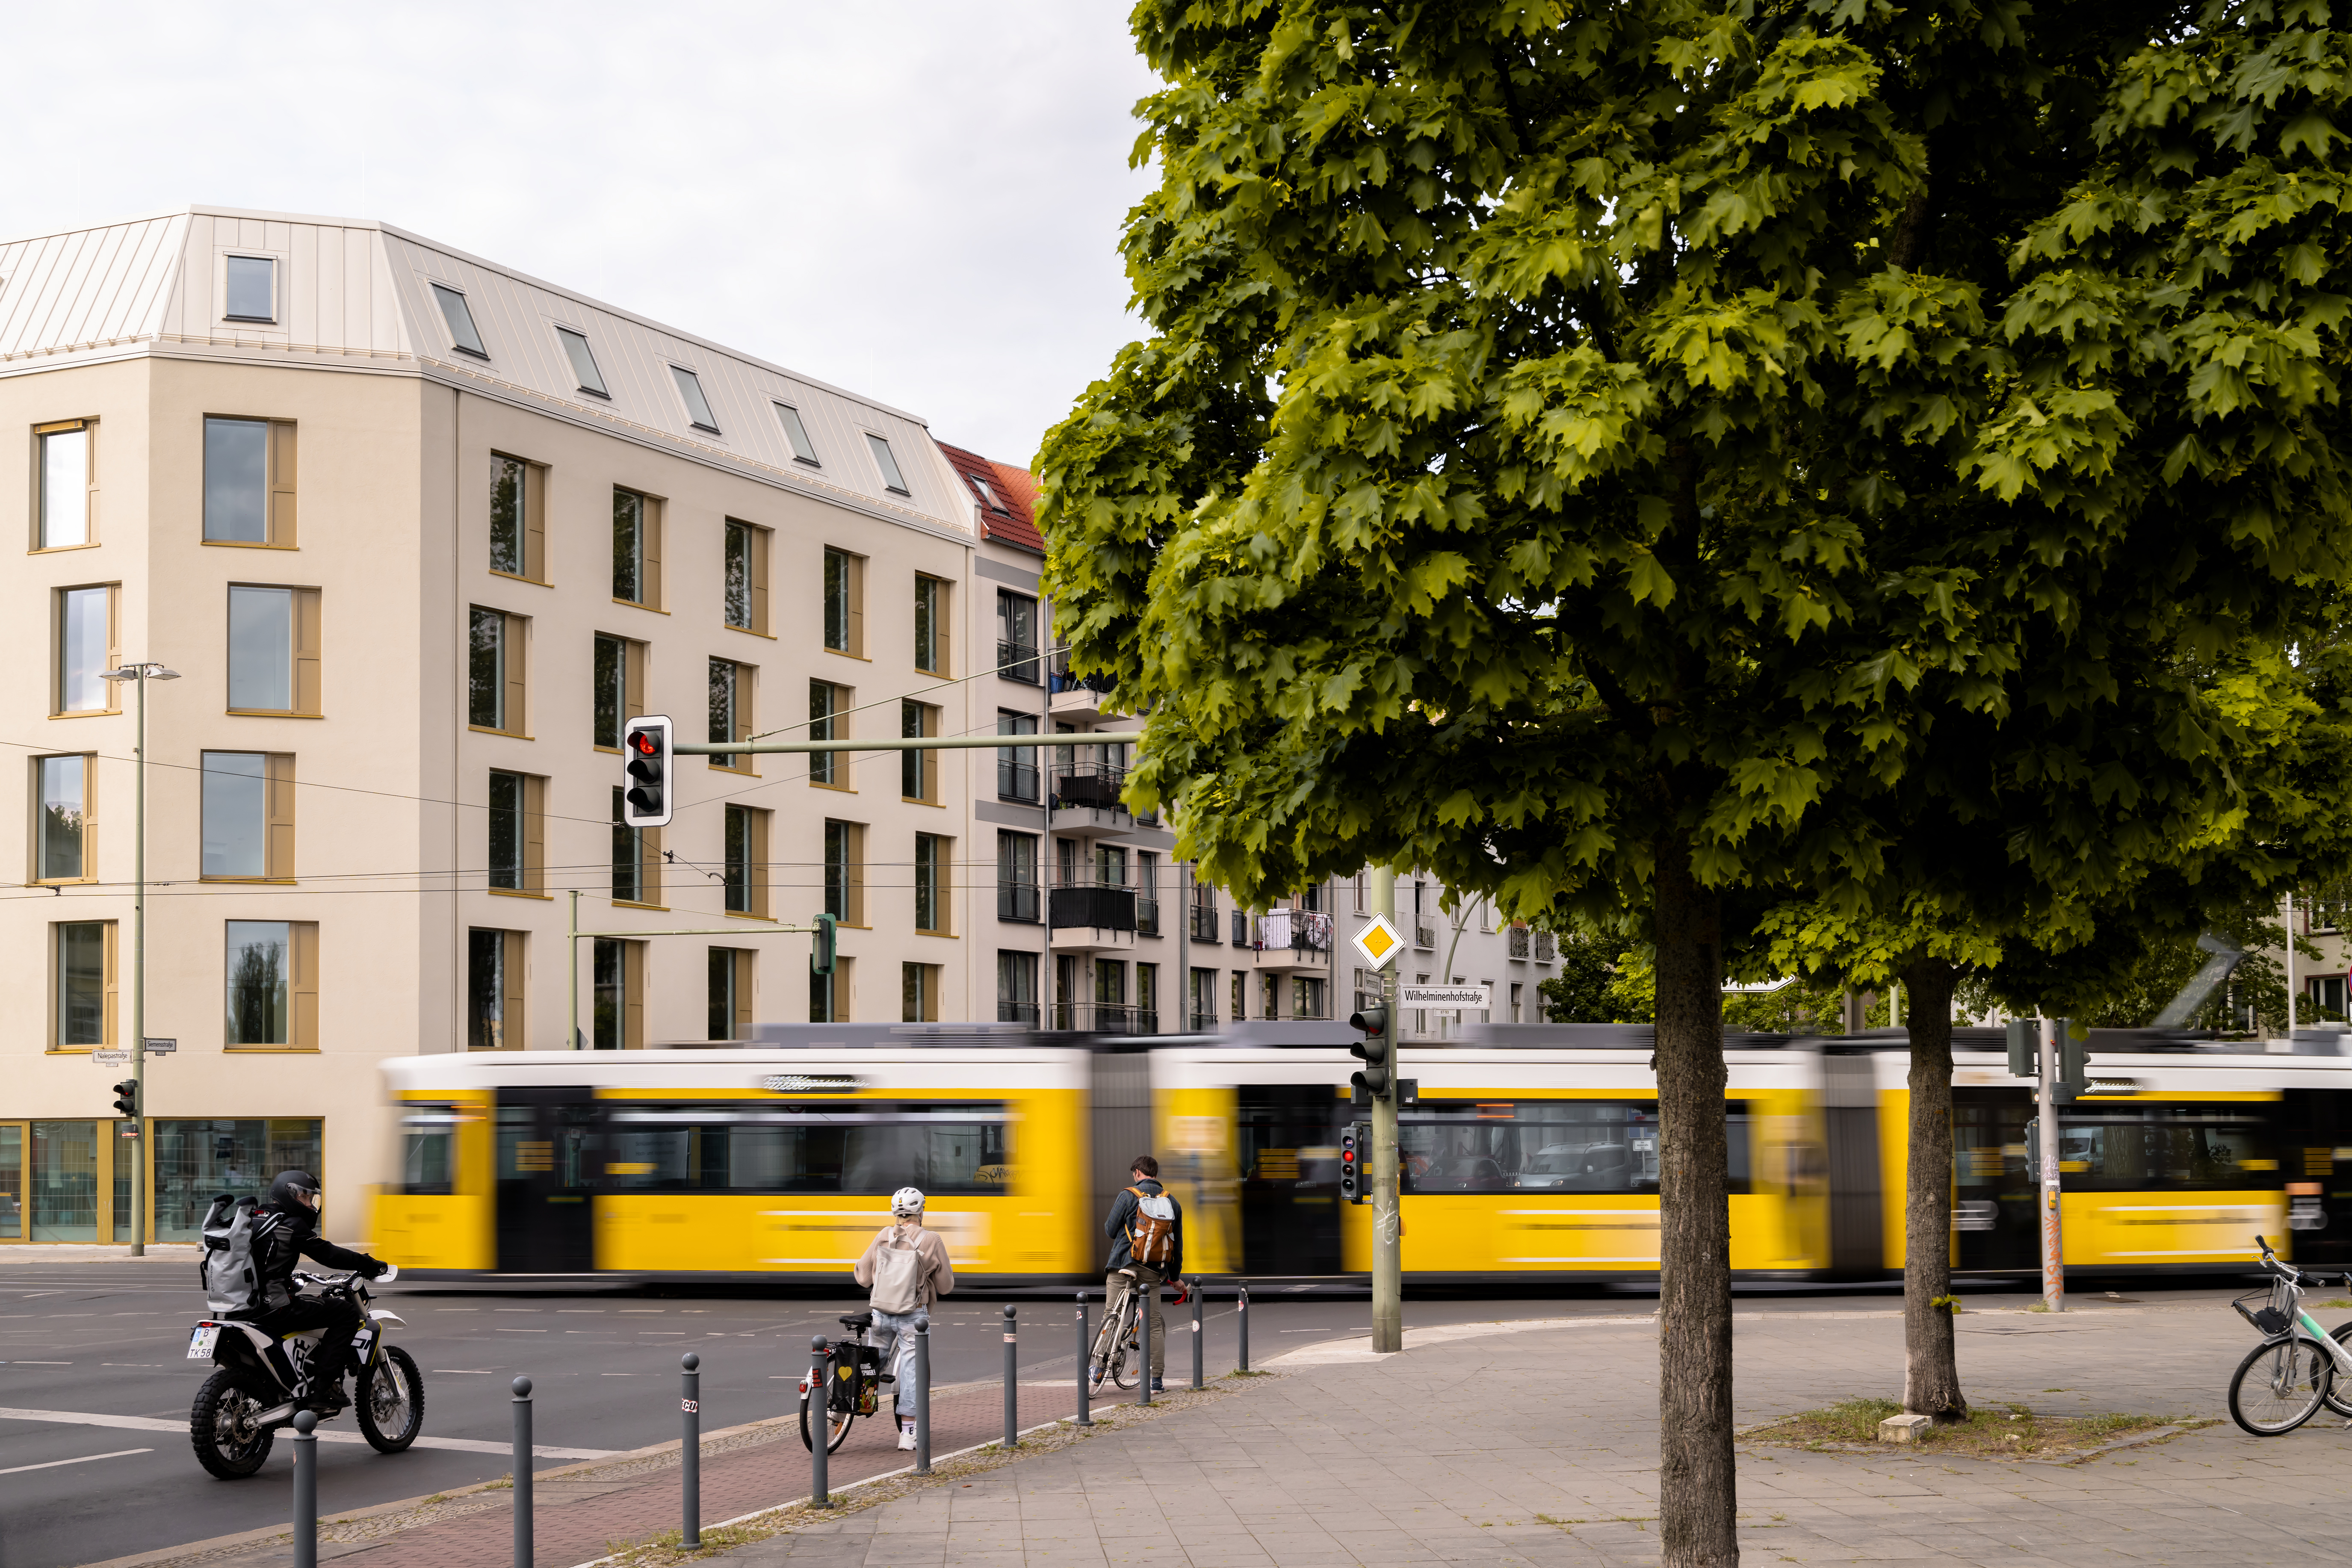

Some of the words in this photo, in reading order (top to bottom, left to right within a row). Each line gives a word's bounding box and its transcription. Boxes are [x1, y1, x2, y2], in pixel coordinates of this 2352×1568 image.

[1405, 990, 1482, 1004] Wilhelminenhofstraße
[203, 1329, 210, 1337] B
[2302, 1321, 2319, 1339] nextbike
[190, 1349, 201, 1357] TK
[201, 1348, 212, 1357] 58
